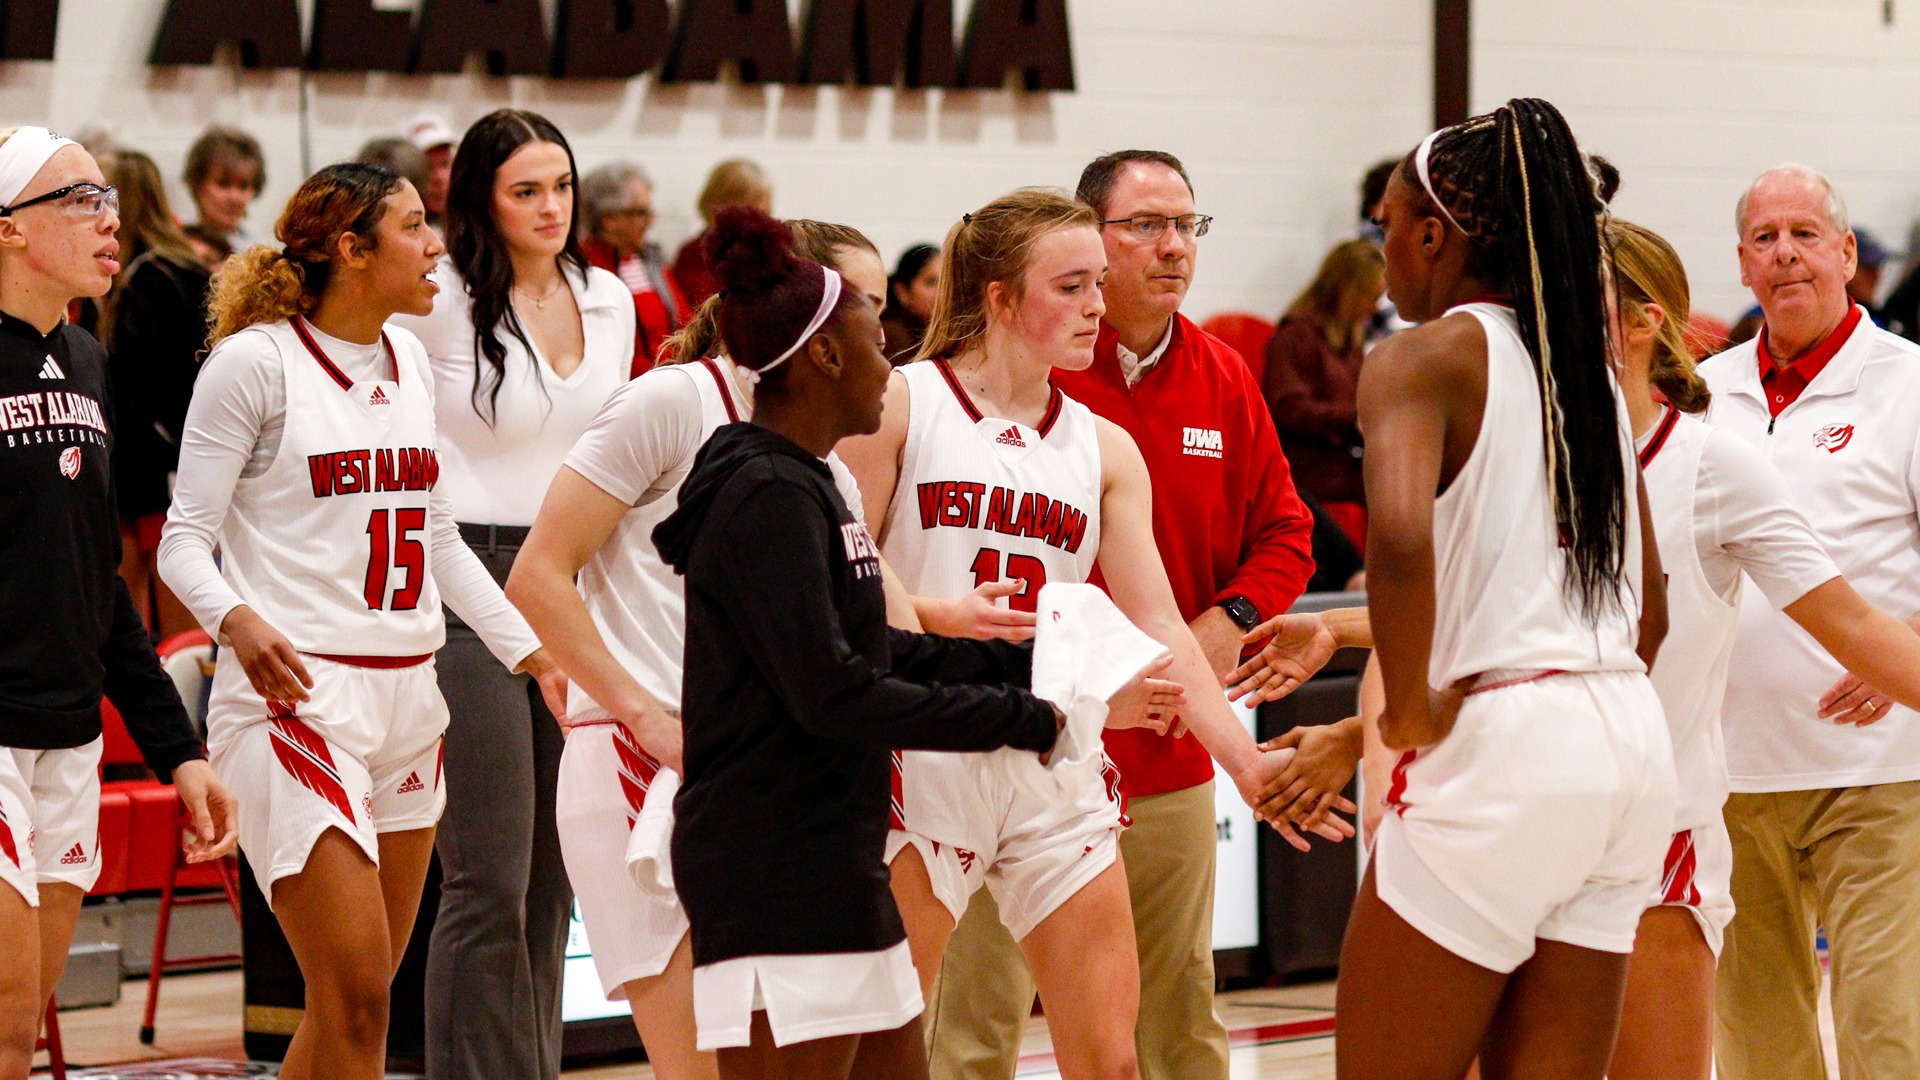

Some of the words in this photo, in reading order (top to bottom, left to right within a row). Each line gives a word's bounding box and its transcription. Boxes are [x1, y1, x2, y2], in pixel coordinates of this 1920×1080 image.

[7, 428, 106, 448] BASKETBALL
[995, 436, 1027, 448] adidas
[1182, 426, 1223, 451] UWA
[1182, 447, 1223, 459] BASKETBALL
[307, 448, 371, 498] WEST
[374, 447, 440, 493] ALABAM
[916, 480, 987, 530] WEST
[363, 507, 426, 611] 15
[396, 783, 425, 794] adidas
[60, 856, 88, 865] adidas
